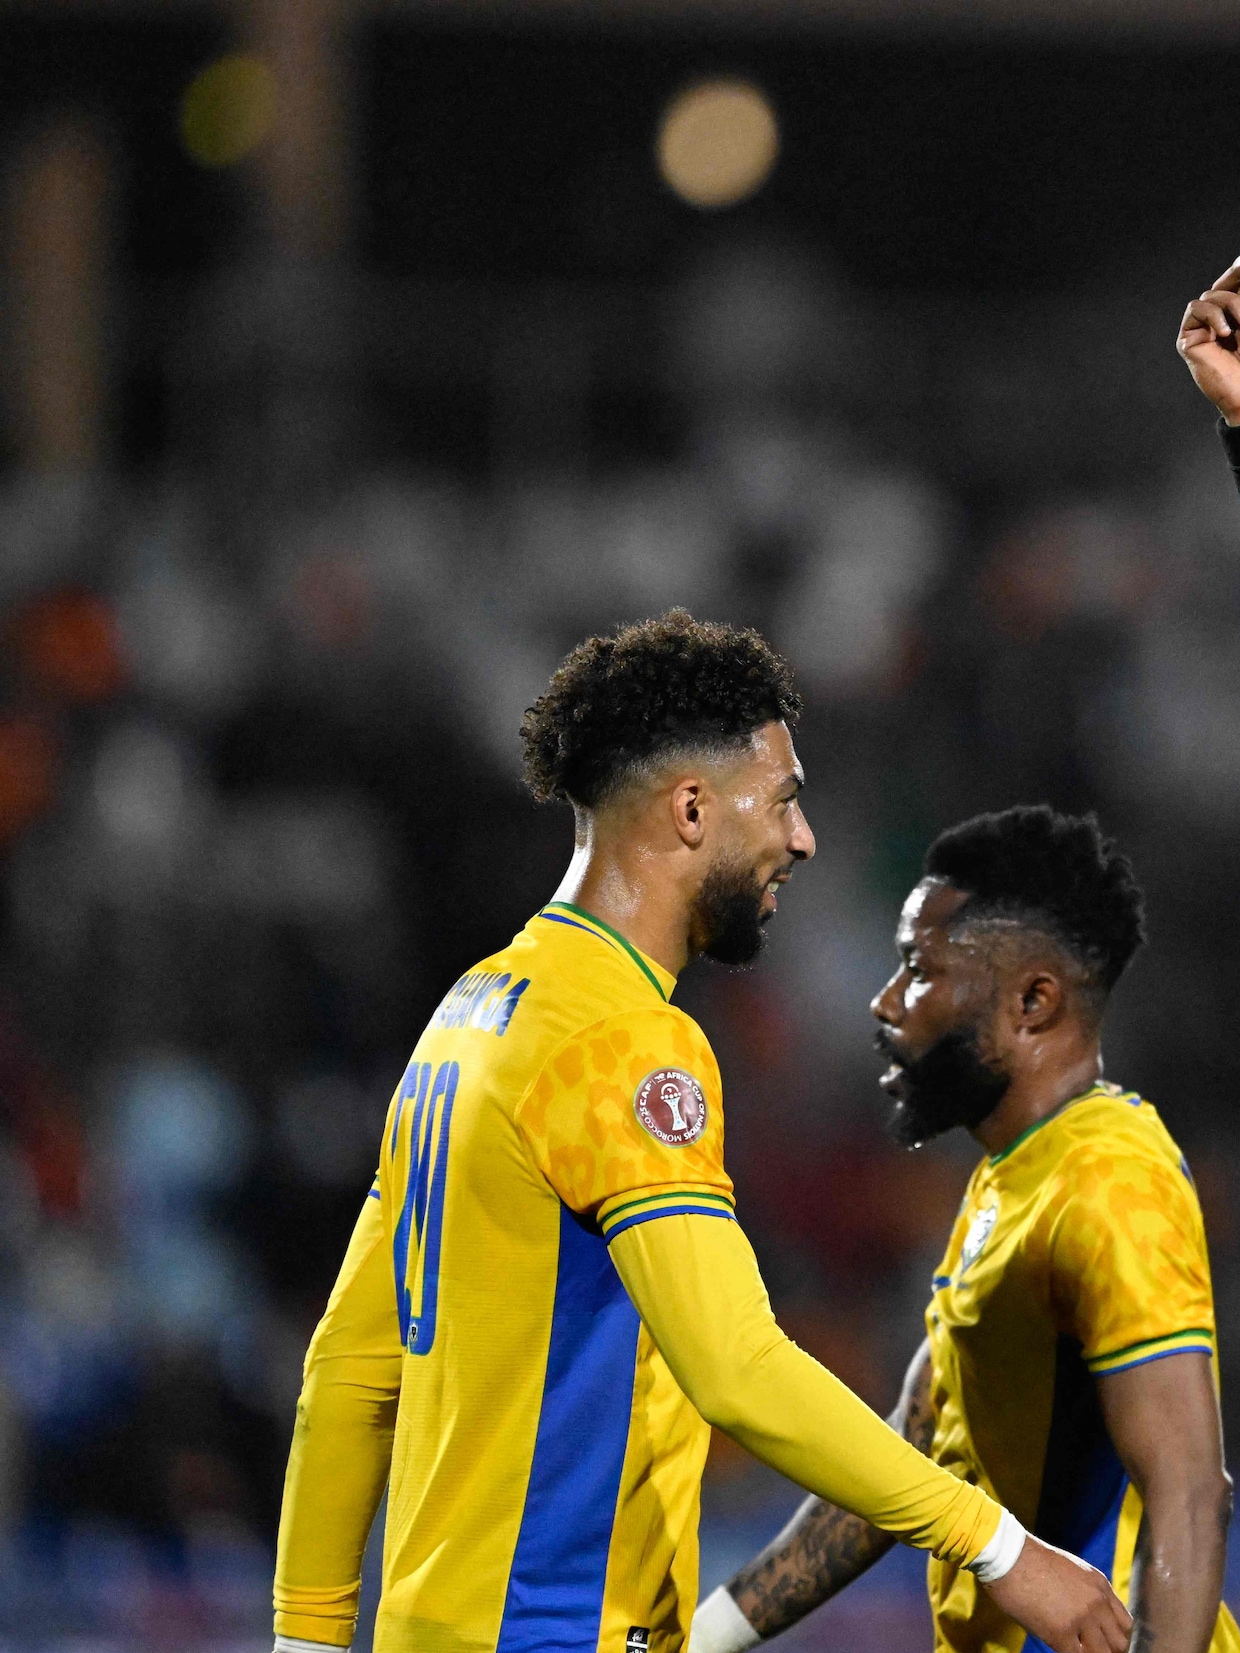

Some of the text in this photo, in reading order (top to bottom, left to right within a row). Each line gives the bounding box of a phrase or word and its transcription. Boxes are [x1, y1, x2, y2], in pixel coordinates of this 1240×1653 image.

[667, 1072, 693, 1087] AFRICA
[692, 1086, 703, 1102] CUP
[698, 1103, 705, 1116] OF
[644, 1117, 682, 1142] MOROCCO
